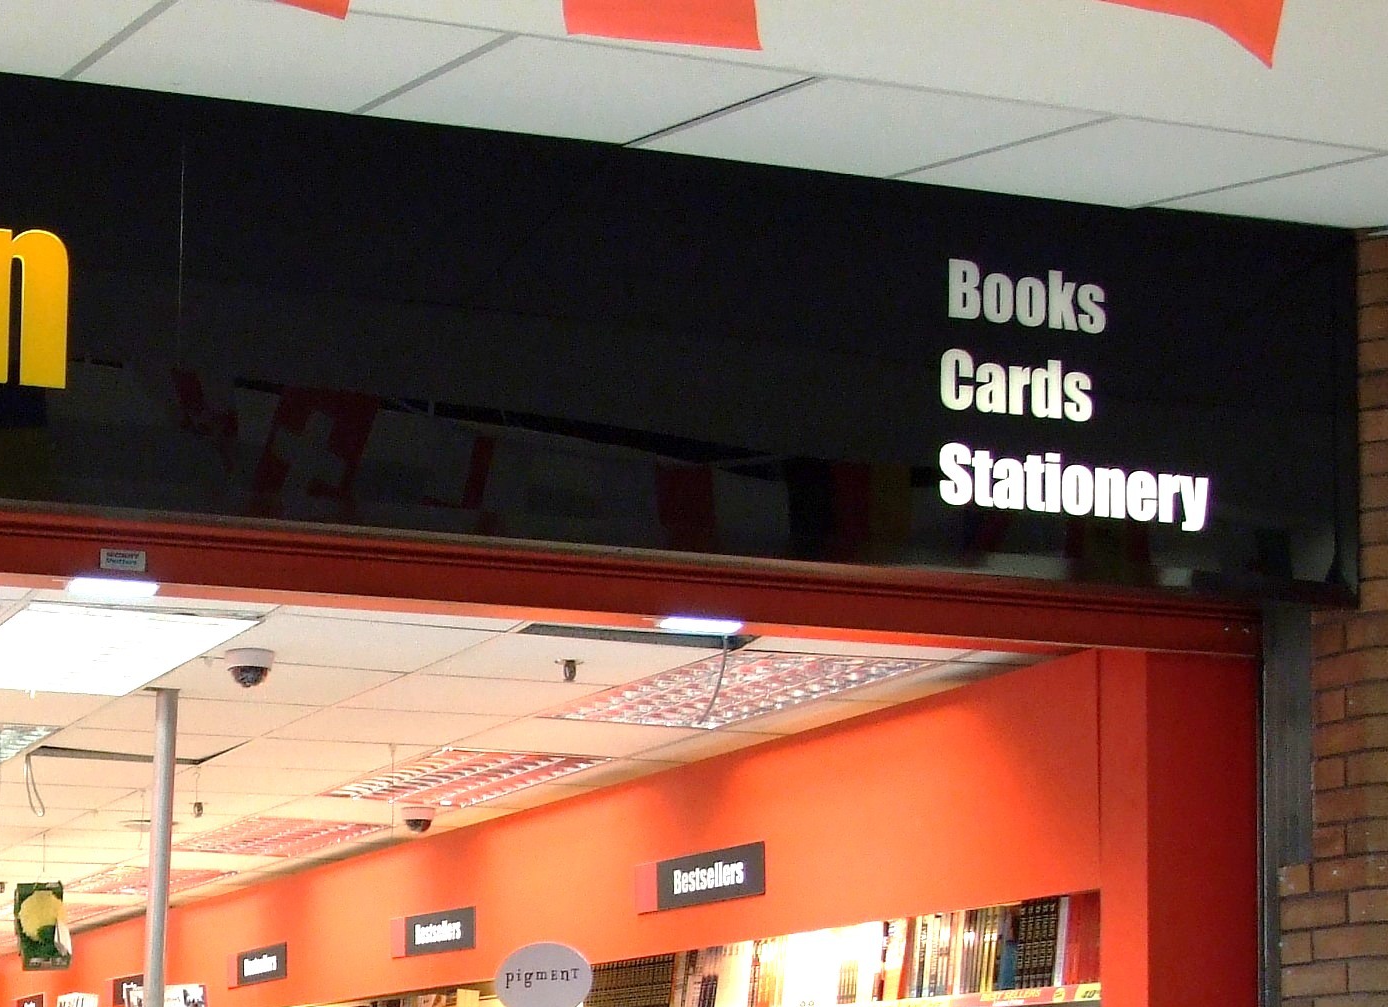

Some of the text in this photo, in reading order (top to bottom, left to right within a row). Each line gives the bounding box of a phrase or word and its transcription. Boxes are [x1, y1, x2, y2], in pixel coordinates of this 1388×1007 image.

[948, 258, 1106, 333] Books
[940, 348, 1093, 422] Cards
[939, 442, 1209, 532] Stationery
[673, 861, 744, 895] Bestsellers
[414, 920, 462, 945] Bestsellers
